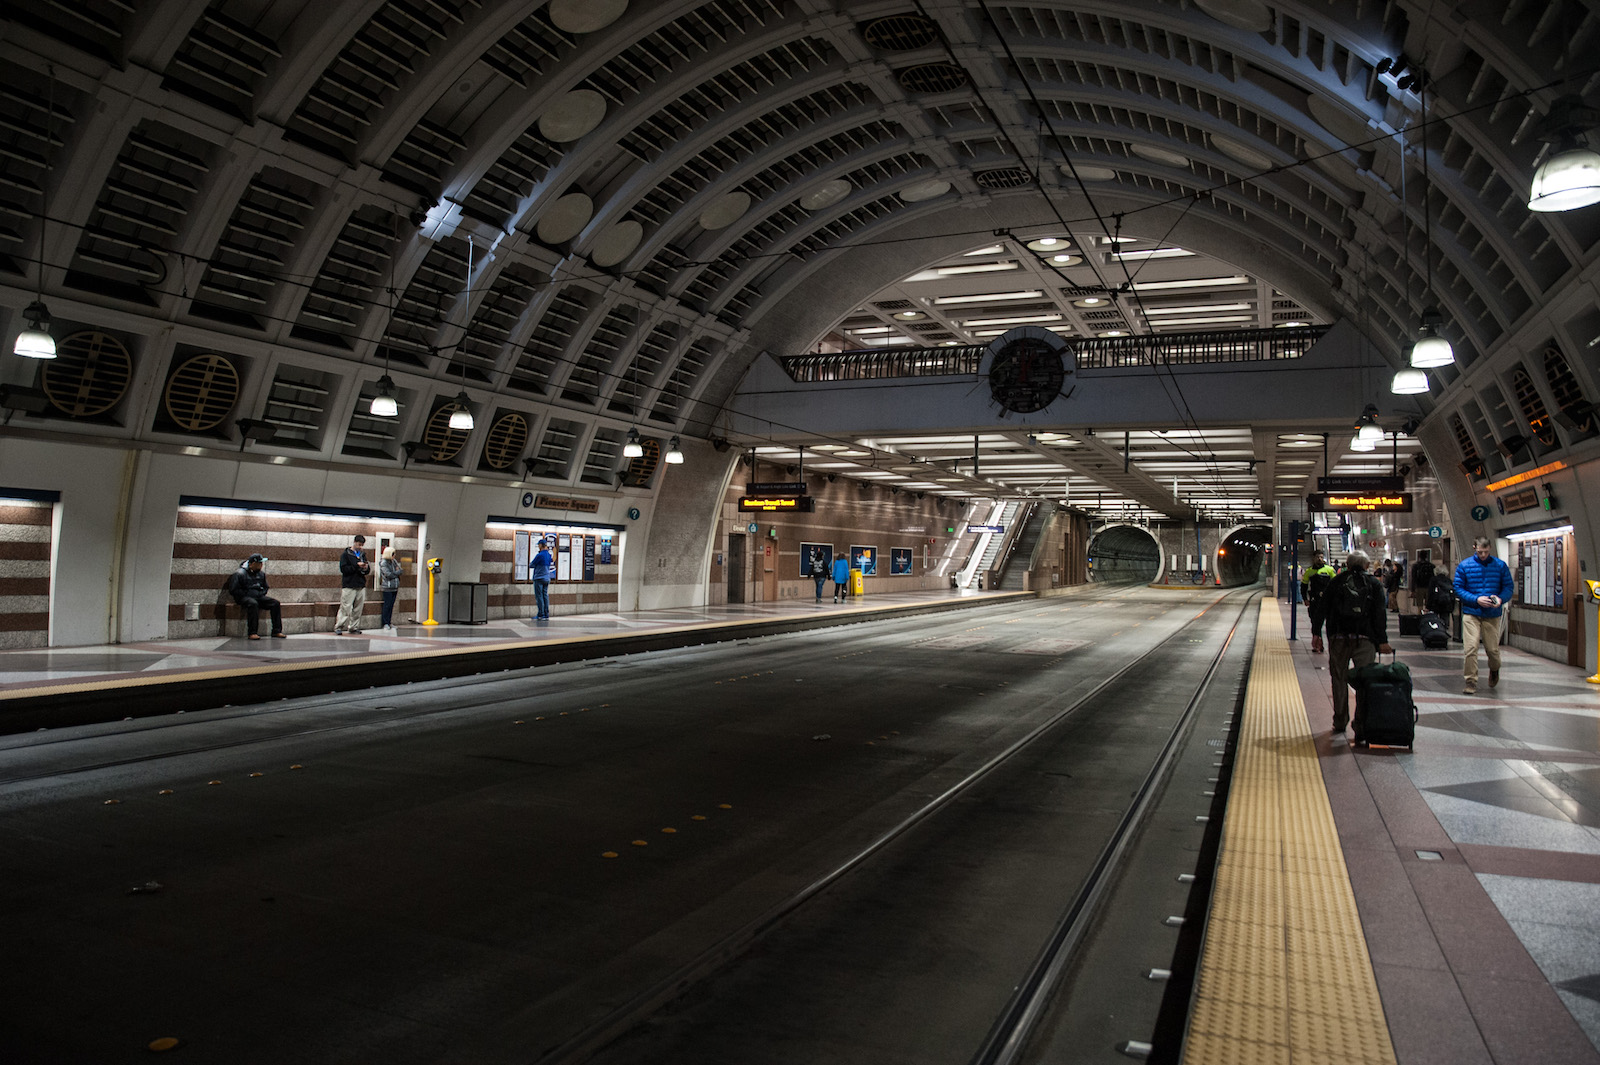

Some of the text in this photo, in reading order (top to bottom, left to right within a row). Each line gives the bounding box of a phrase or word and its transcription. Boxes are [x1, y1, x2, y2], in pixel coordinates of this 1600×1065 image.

[540, 496, 596, 510] Pioneer Square
[1304, 522, 1310, 533] 2
